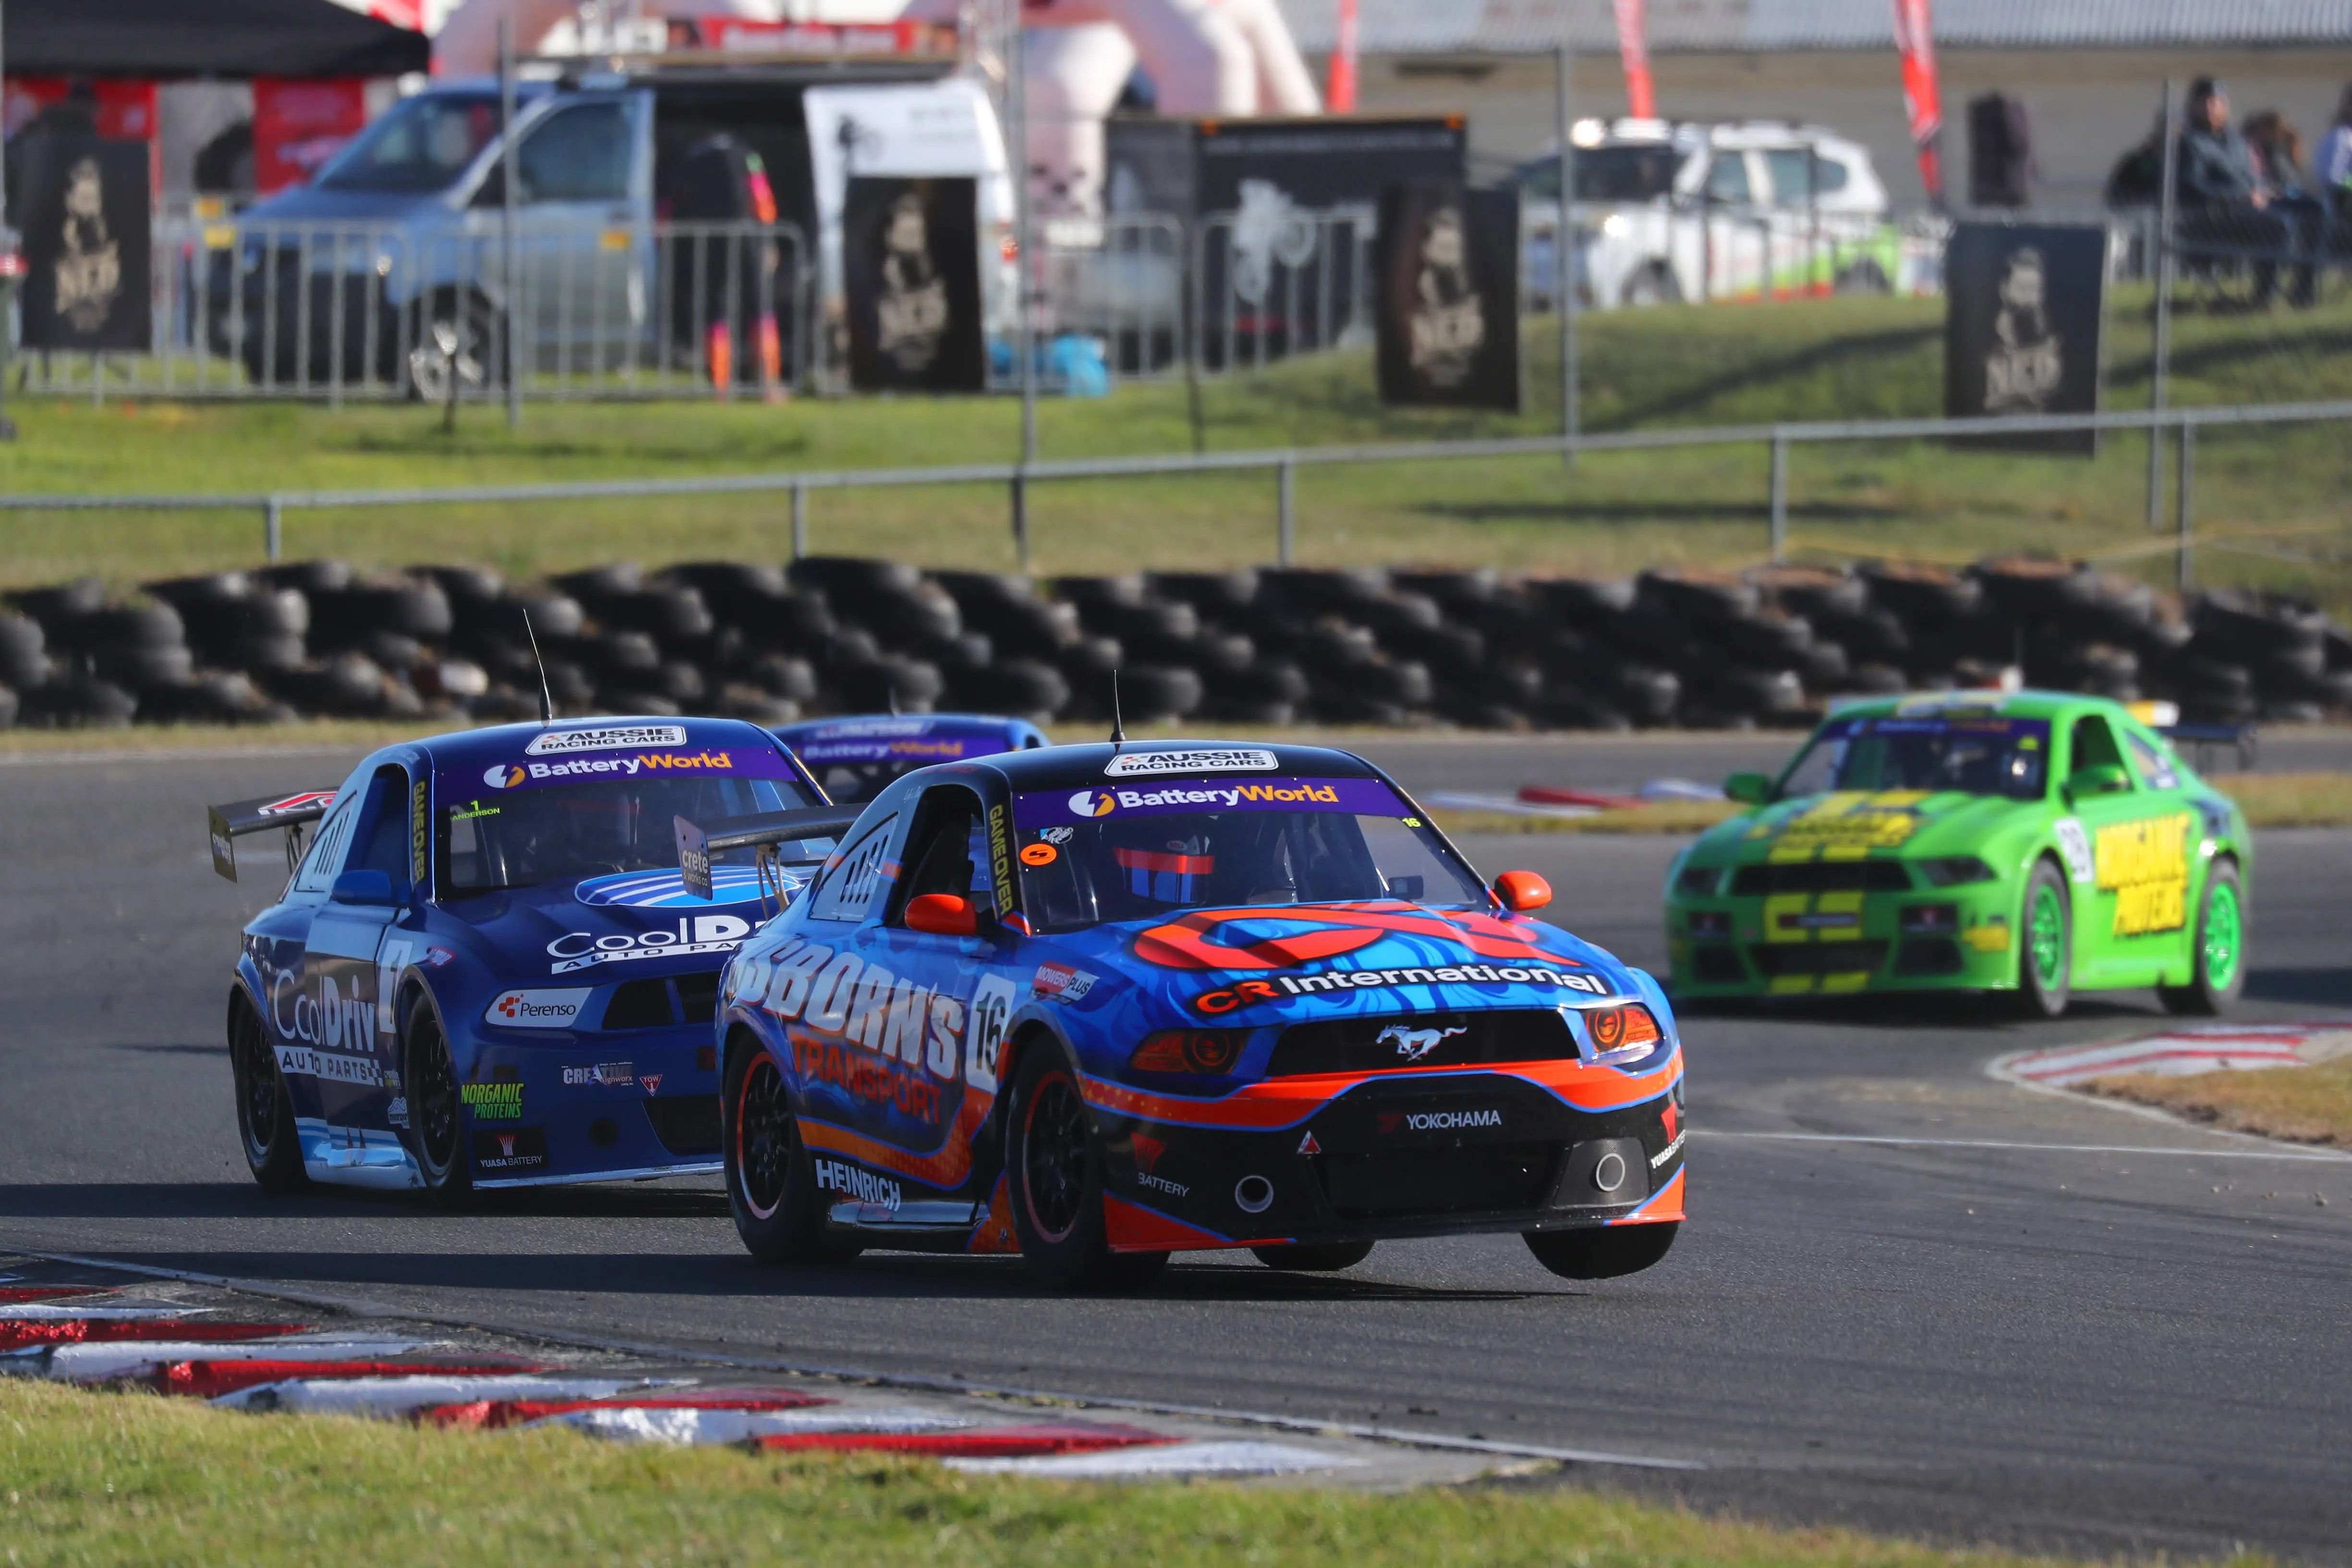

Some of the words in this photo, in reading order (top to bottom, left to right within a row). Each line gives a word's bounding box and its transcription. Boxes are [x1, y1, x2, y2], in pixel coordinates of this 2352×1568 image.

[541, 738, 616, 750] RACING
[622, 736, 676, 744] CARS
[566, 728, 674, 741] AUSSIE
[1121, 760, 1201, 771] RACING
[1204, 759, 1266, 767] CARS
[1148, 752, 1263, 762] AUSSIE
[452, 808, 500, 821] ANDERSON
[471, 800, 479, 811] 1
[1402, 817, 1421, 827] 16
[682, 850, 709, 874] crete
[562, 948, 663, 970] AUTO
[1035, 965, 1071, 988] MOWERS
[1067, 977, 1091, 995] PLUS
[1196, 981, 1280, 1014] CR
[1279, 965, 1608, 995] International
[520, 1003, 576, 1017] Perenso
[976, 991, 1006, 1076] 16
[283, 1051, 321, 1074] AUTO
[328, 1058, 367, 1081] PARTS
[790, 1032, 941, 1124] TRANSPORT
[461, 1083, 524, 1104] NORGANIC
[474, 1103, 522, 1119] PROTEINS
[1406, 1110, 1502, 1130] YOKOHAMA
[480, 1159, 508, 1167] YUASA
[508, 1155, 542, 1166] BATTERY
[815, 1159, 901, 1212] HEINRICH
[1139, 1172, 1190, 1197] BATTERY
